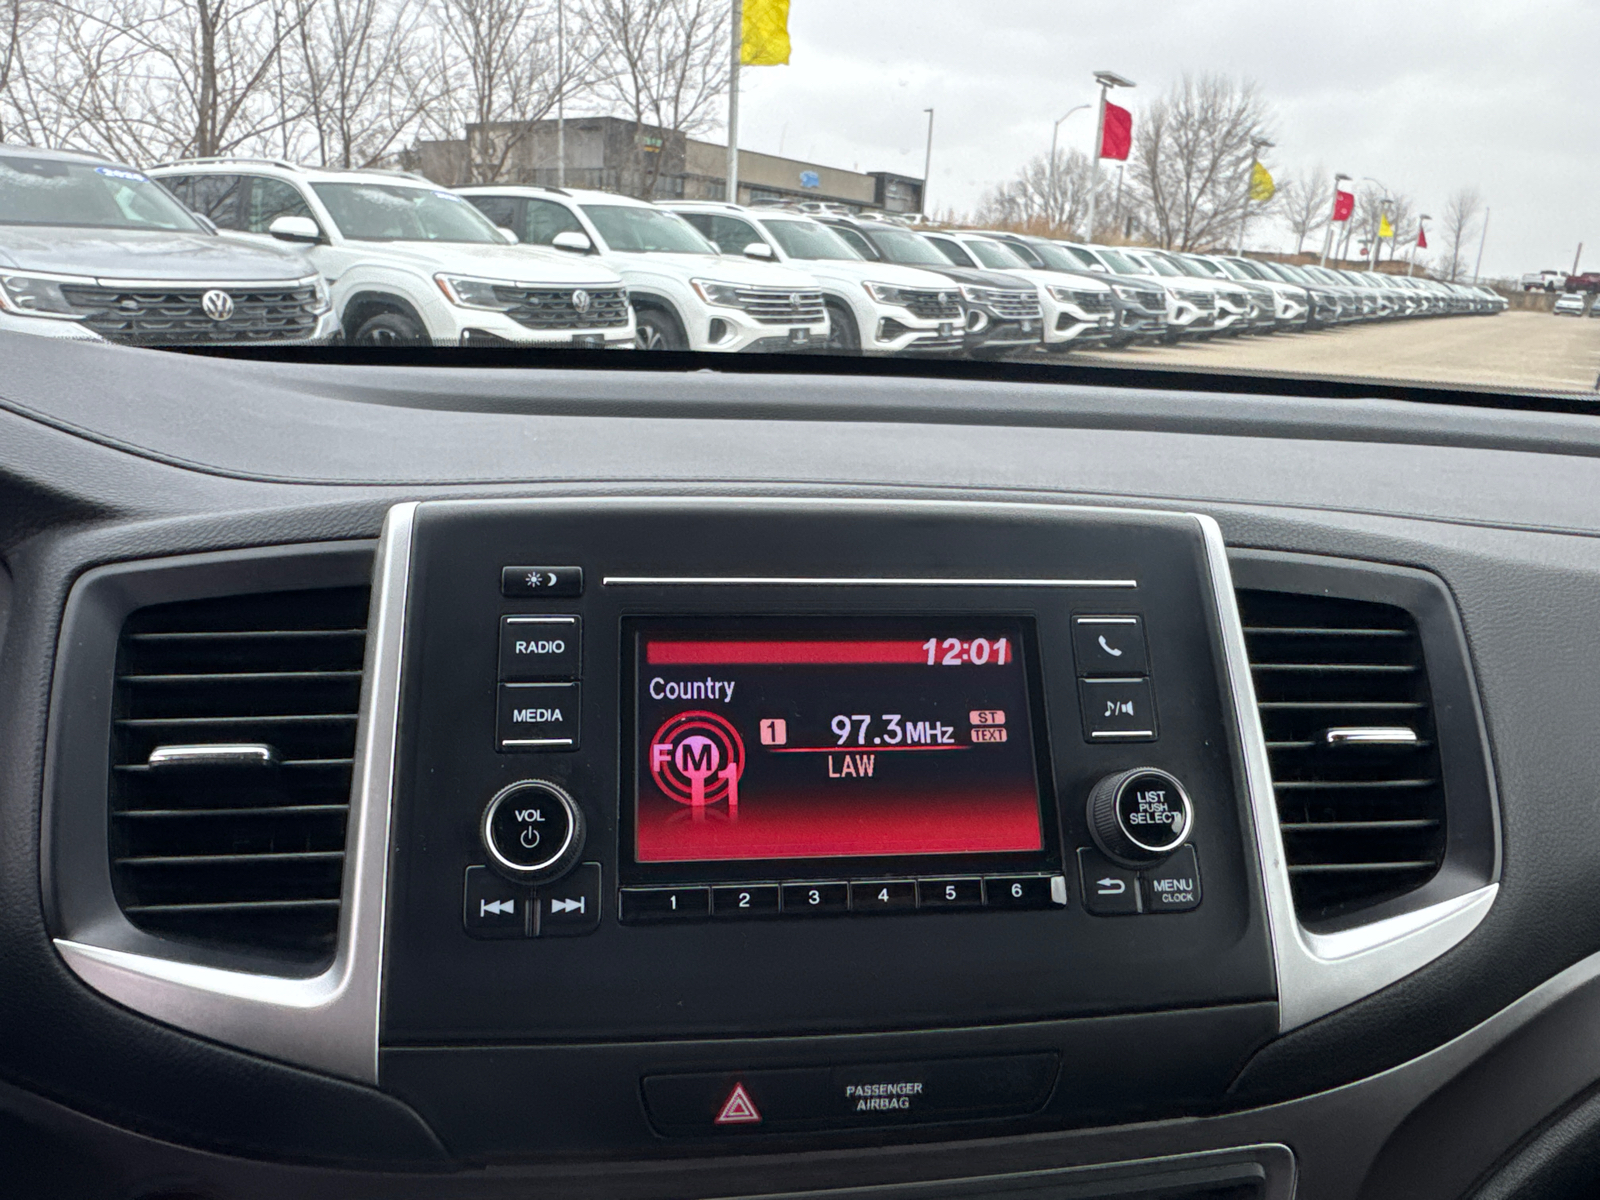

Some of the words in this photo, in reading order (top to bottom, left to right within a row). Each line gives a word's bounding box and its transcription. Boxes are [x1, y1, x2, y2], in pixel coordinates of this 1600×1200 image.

[515, 640, 565, 654] RADIO
[922, 638, 1007, 665] 12:01
[650, 677, 736, 703] Country
[513, 709, 563, 722] MEDIA
[978, 712, 998, 723] ST
[974, 729, 1004, 741] TEXT
[828, 755, 875, 778] LAW
[1137, 791, 1166, 803] LIST
[1139, 803, 1168, 813] PUSH
[515, 809, 545, 822] VOL
[1130, 811, 1182, 825] SELECT
[1011, 883, 1023, 898] 6
[1153, 879, 1193, 892] MENU
[739, 892, 751, 908] 2
[808, 890, 820, 905] 3
[877, 888, 889, 903] 4
[945, 886, 957, 900] 5
[1162, 893, 1194, 903] CLOCK
[845, 1083, 923, 1098] PASSENGER
[856, 1097, 910, 1111] AIRBAG
